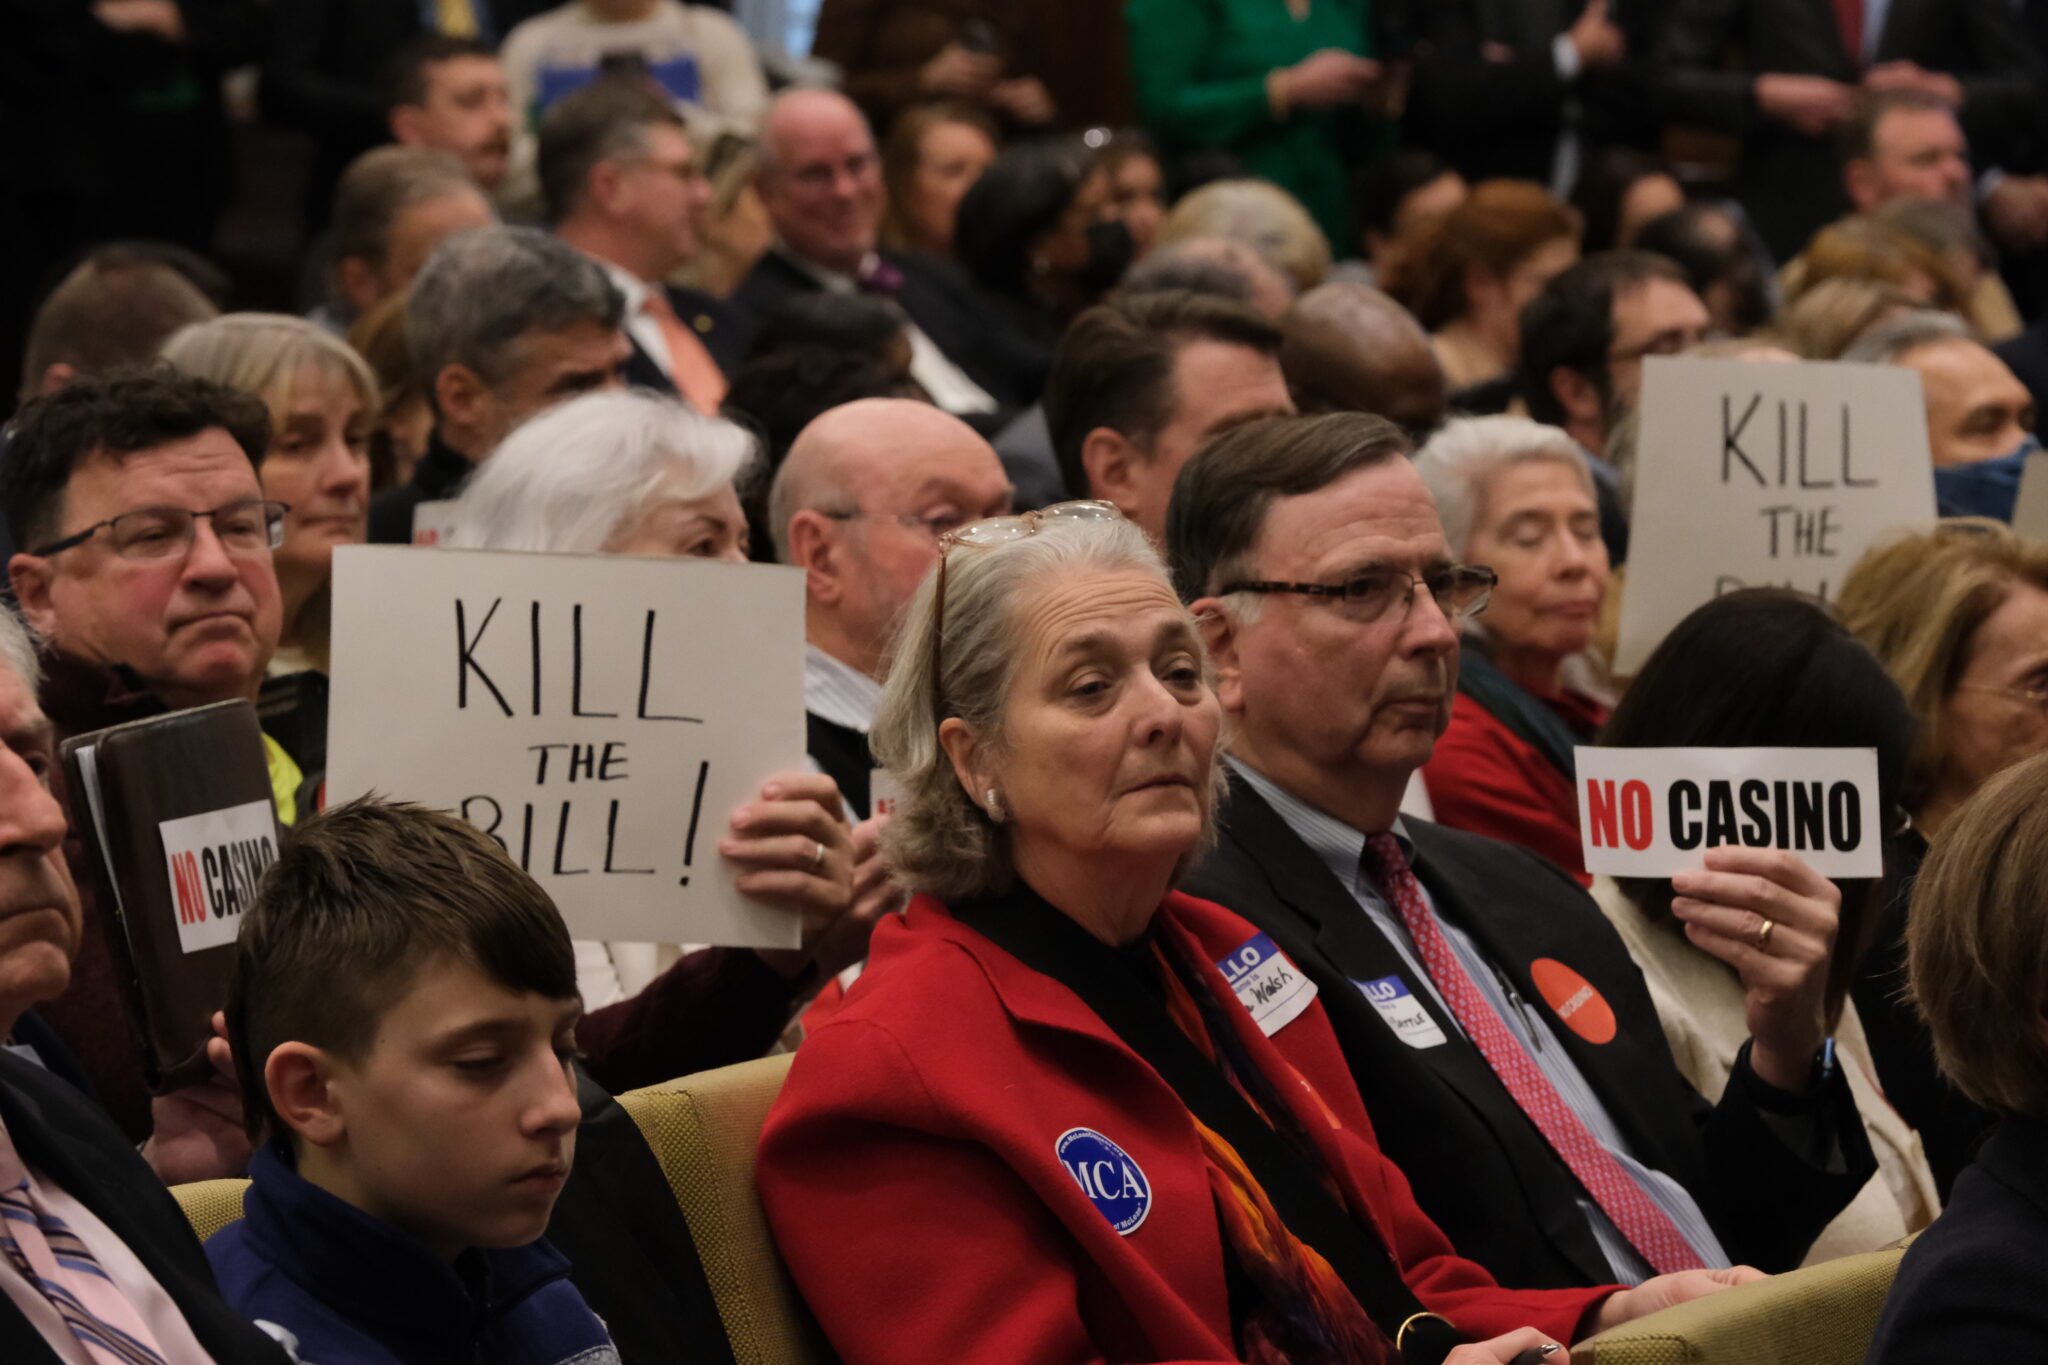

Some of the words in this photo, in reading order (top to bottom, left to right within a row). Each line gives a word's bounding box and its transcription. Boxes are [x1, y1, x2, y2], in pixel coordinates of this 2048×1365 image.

[1721, 392, 1879, 489] KILL
[1759, 505, 1843, 558] THE
[456, 598, 703, 723] KILL
[528, 742, 628, 785] THE
[1587, 778, 1653, 851] NO
[1668, 778, 1862, 852] CASINO
[171, 850, 206, 925] NO
[1219, 946, 1260, 984] LLO
[1249, 966, 1293, 1004] Walsh
[1061, 1160, 1146, 1200] MCA
